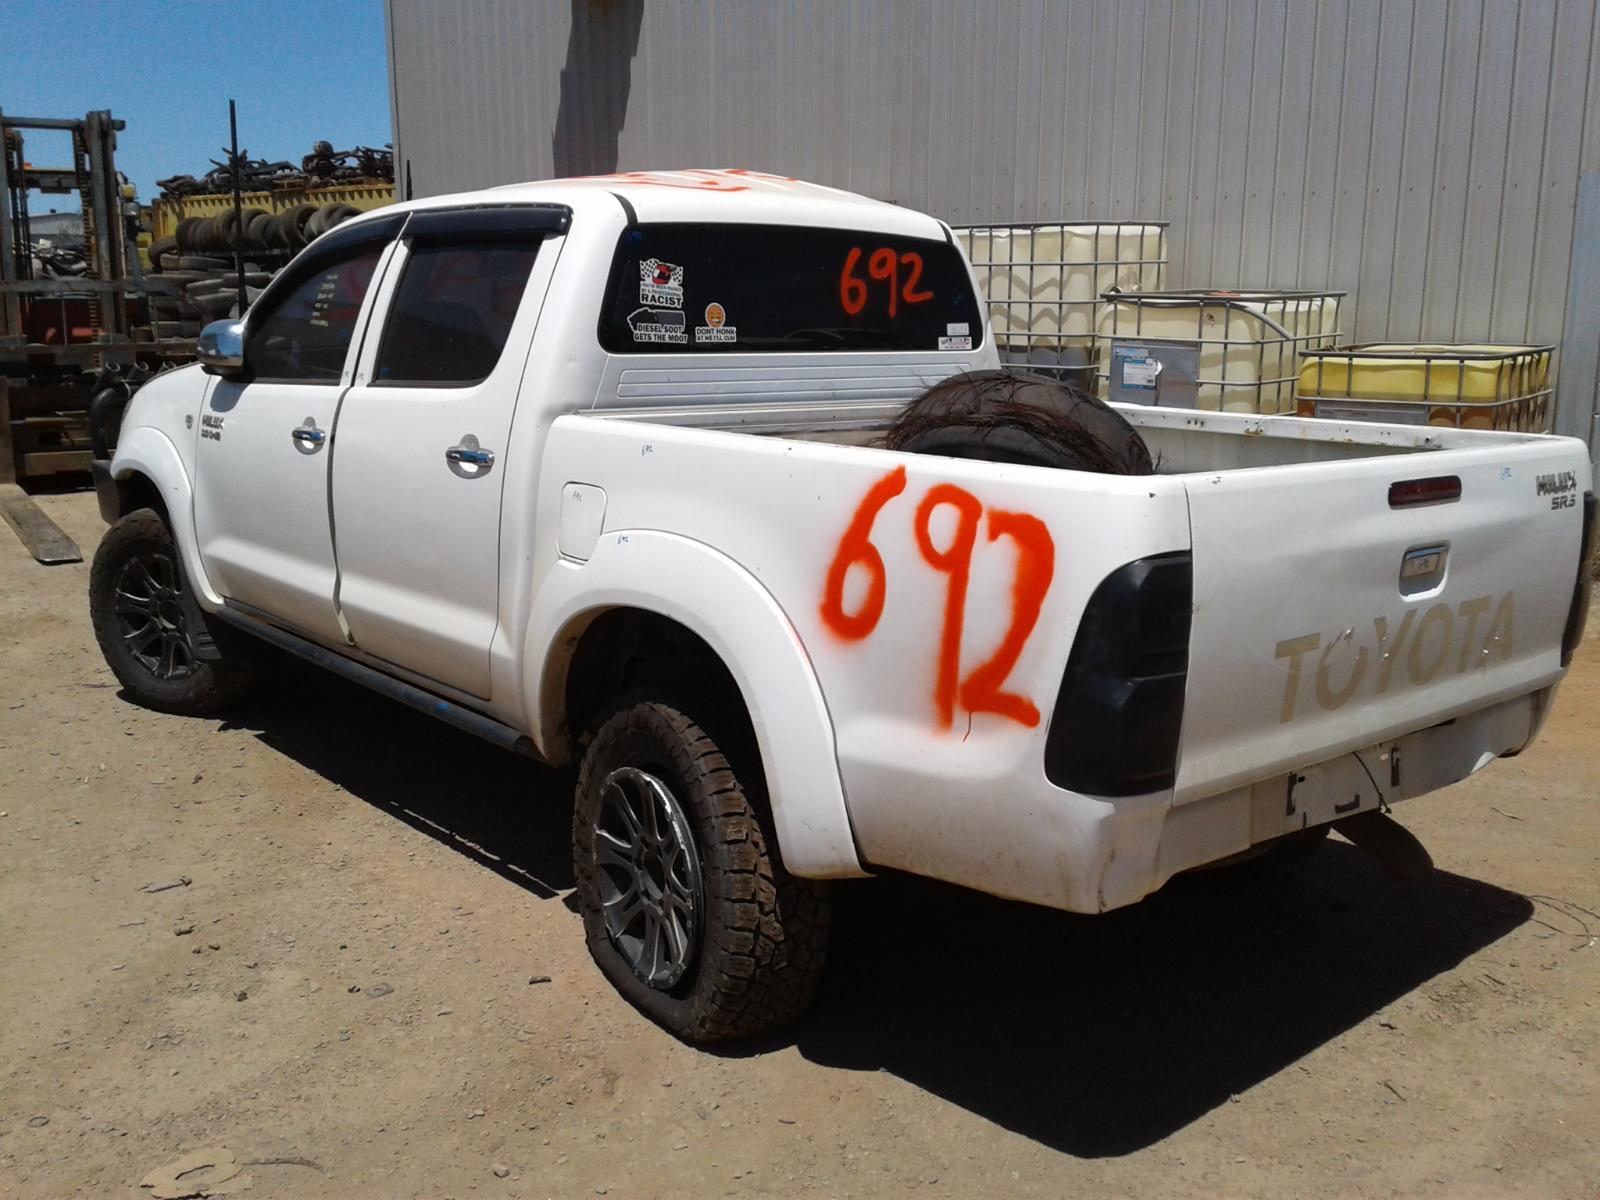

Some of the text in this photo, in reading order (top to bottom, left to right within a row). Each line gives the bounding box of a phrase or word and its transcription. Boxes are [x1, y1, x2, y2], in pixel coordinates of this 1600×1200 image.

[841, 247, 934, 318] 692
[641, 293, 682, 306] RACIST
[637, 323, 682, 334] DIESEL SOOT
[716, 328, 736, 336] HONK
[634, 332, 688, 343] GETS THE MOOT
[820, 465, 1056, 733] 692
[1274, 590, 1515, 724] TOYOTA
